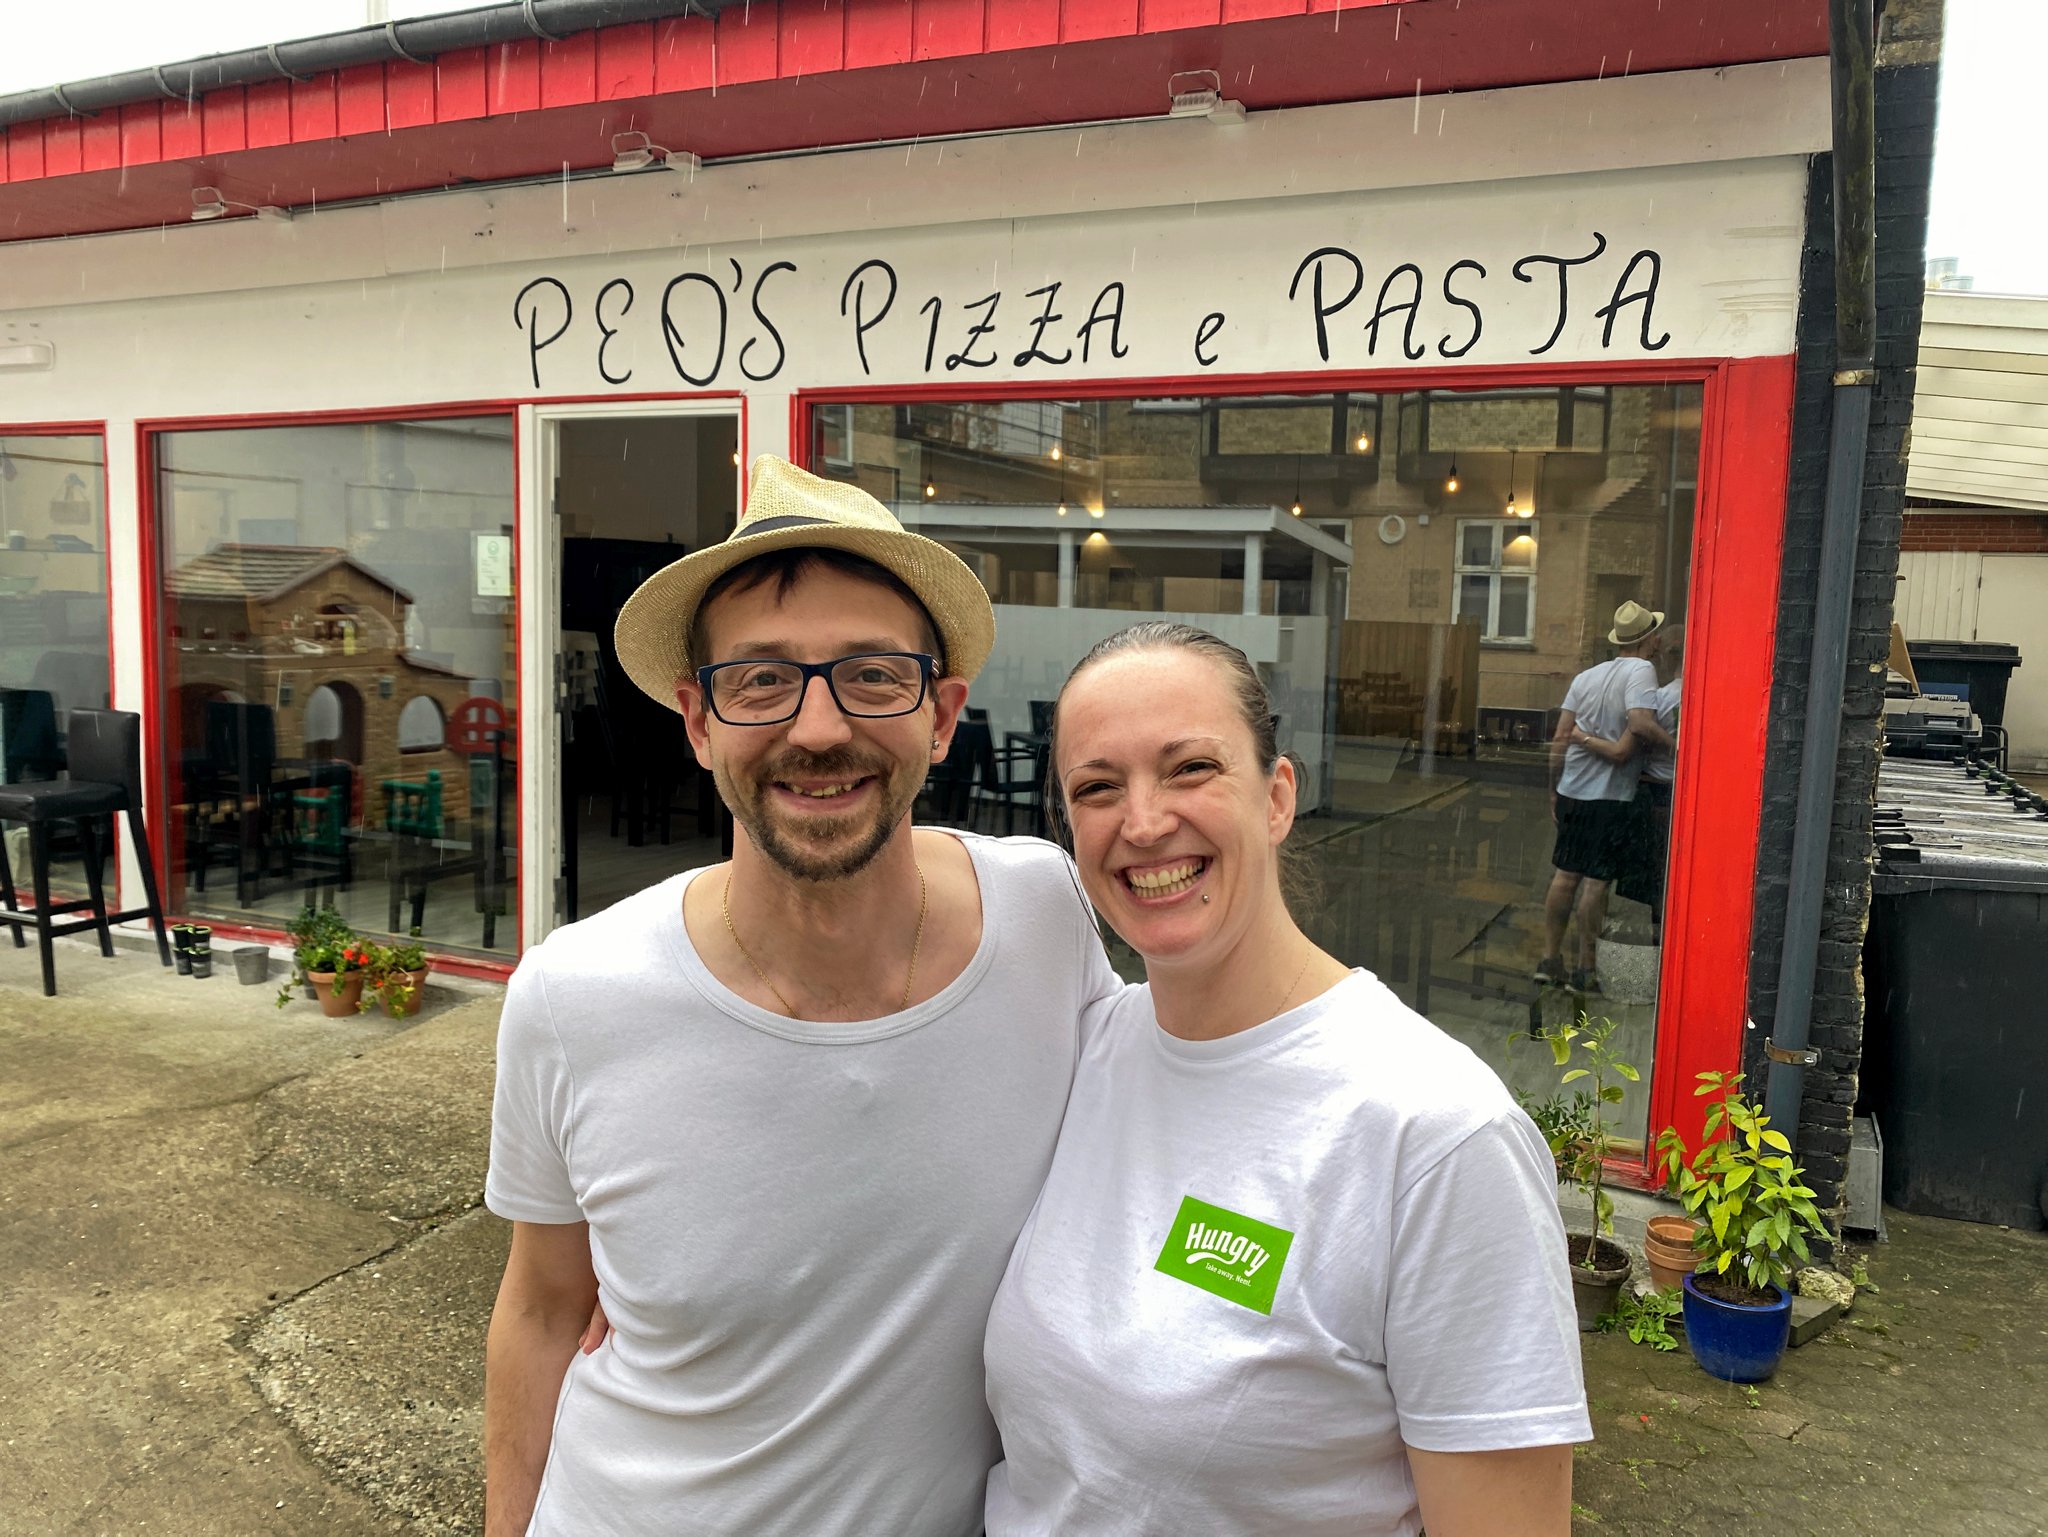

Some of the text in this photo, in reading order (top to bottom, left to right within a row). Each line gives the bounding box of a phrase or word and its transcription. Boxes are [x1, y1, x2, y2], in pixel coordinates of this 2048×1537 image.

[514, 257, 797, 388] PEO'S
[1194, 312, 1225, 366] e
[1289, 231, 1671, 362] PASTA
[1184, 1222, 1271, 1277] Hungry
[1205, 1262, 1218, 1273] Take
